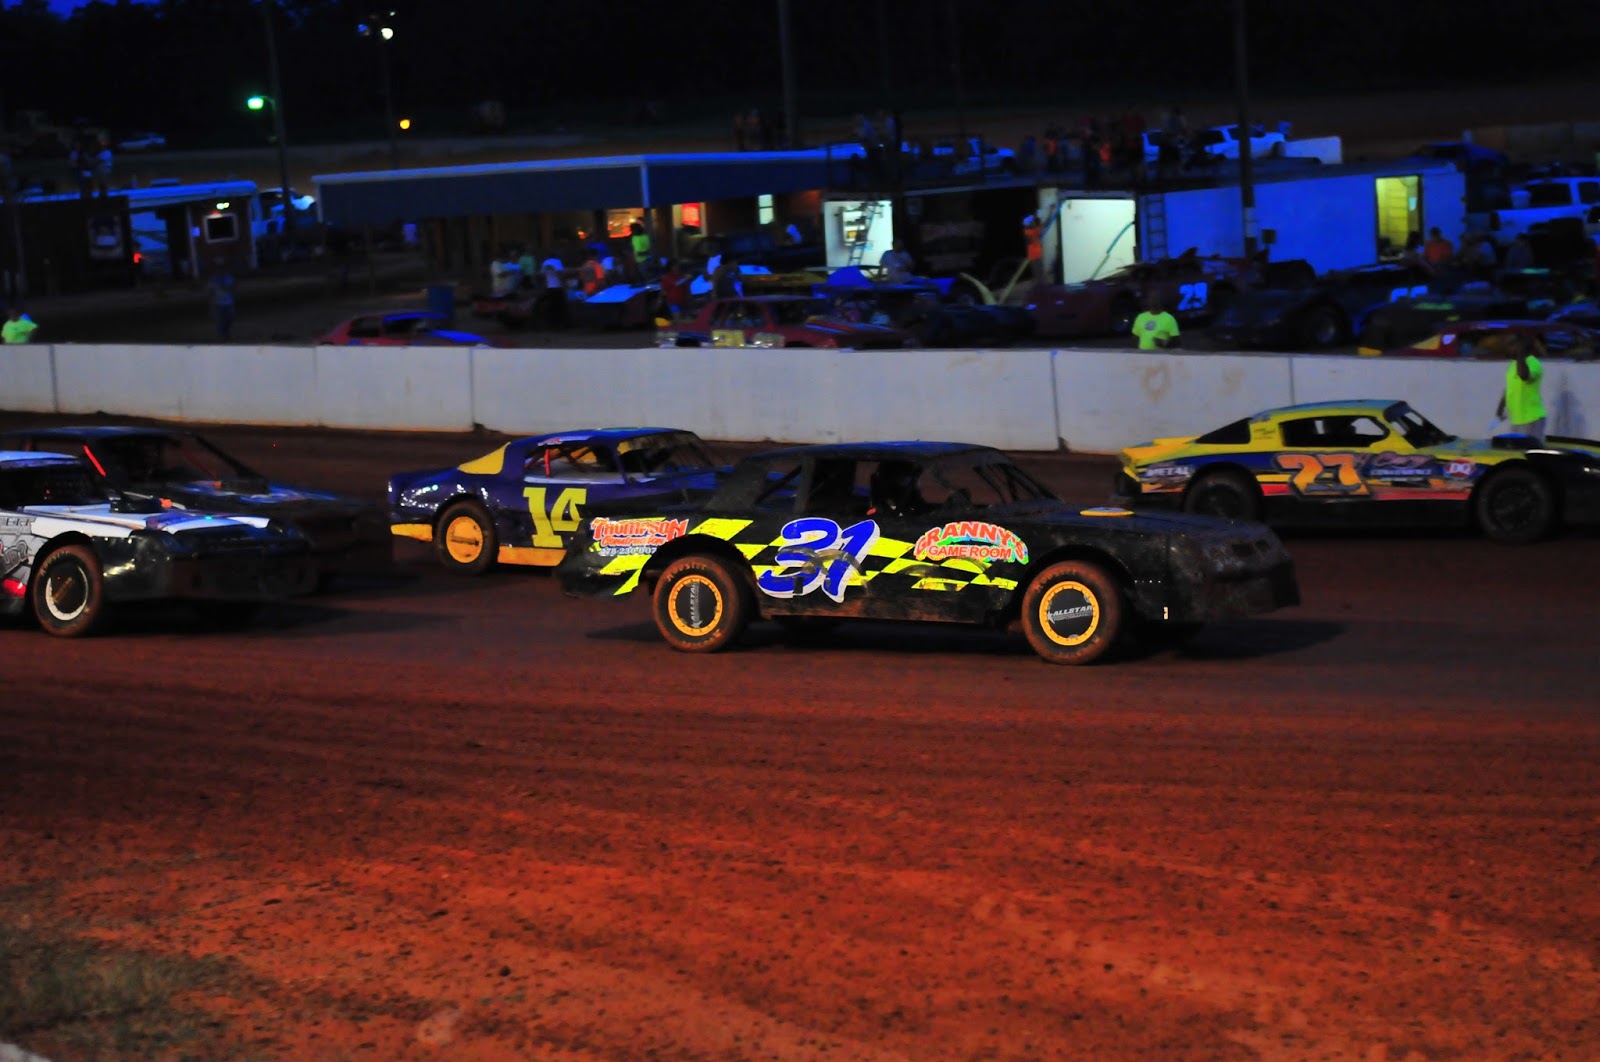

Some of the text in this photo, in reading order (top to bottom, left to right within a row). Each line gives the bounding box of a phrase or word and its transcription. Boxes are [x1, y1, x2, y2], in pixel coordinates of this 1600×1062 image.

[523, 487, 587, 548] 14
[758, 517, 881, 603] 31
[914, 522, 1027, 563] GRANNY'S
[928, 546, 1012, 559] GAME ROOM
[1052, 605, 1093, 616] ALLSTAR
